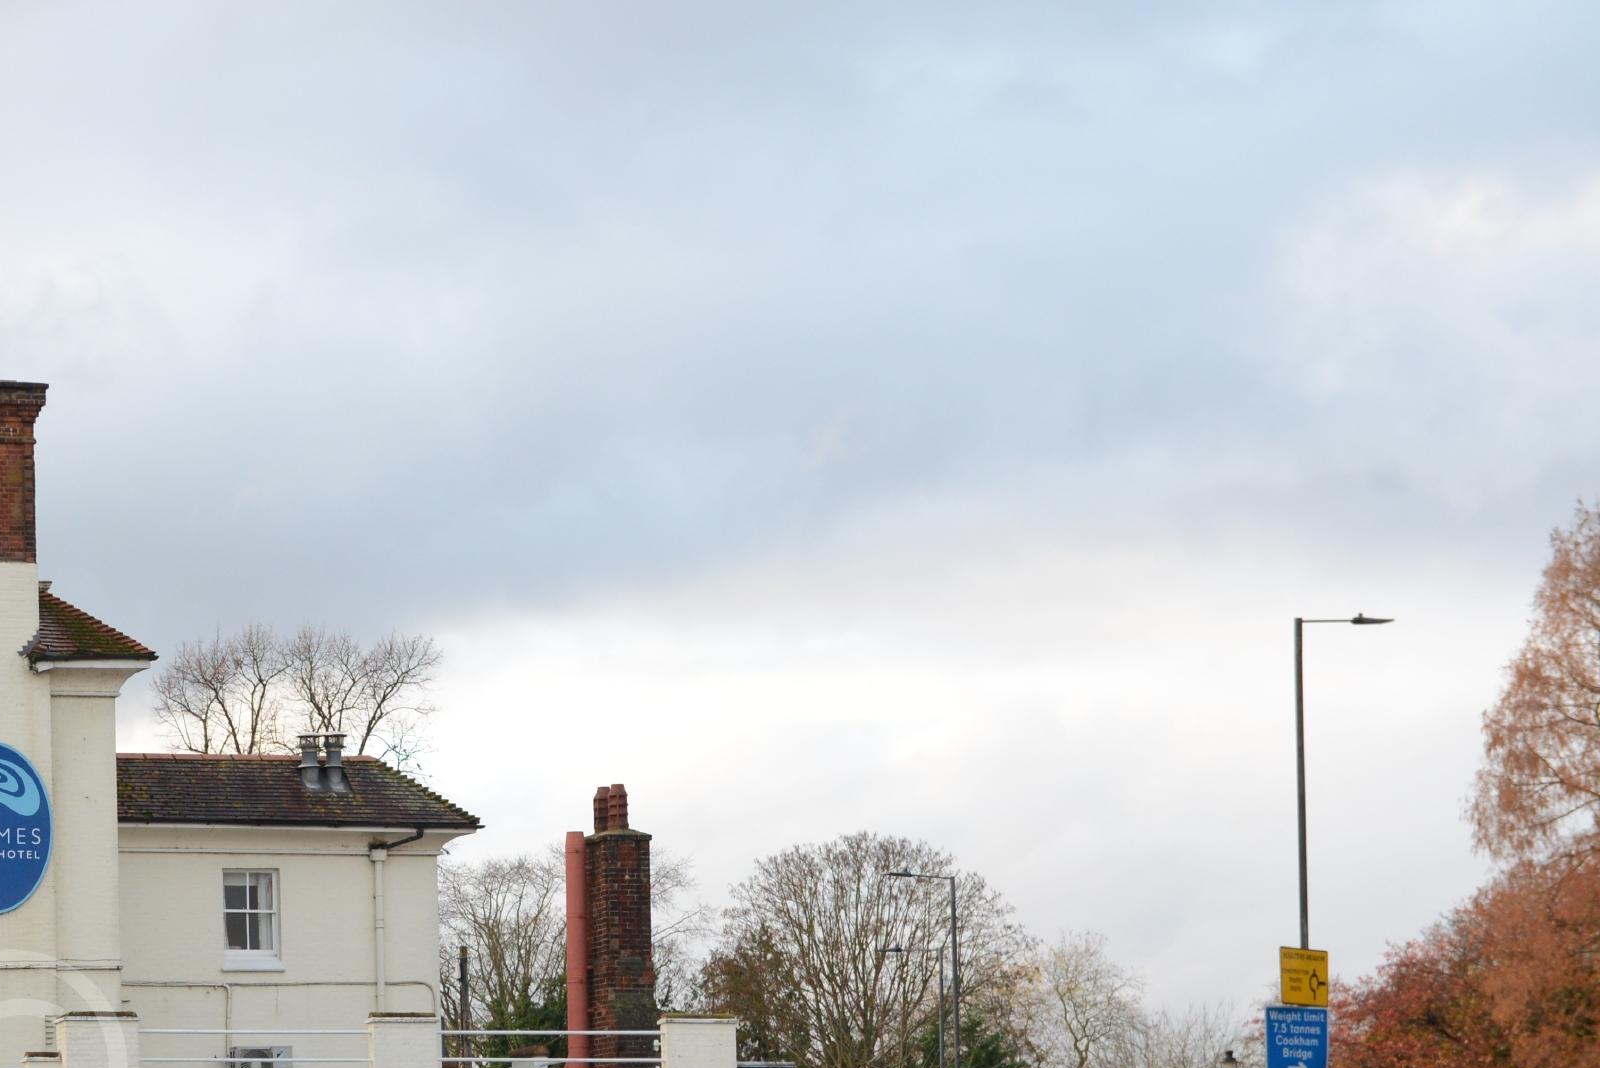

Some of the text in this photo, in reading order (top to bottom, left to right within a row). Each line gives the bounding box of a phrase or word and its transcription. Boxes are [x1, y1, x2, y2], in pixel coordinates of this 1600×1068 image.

[1269, 1010, 1325, 1023] Weight limit
[1273, 1023, 1321, 1035] 7.5 tonnes
[1275, 1035, 1319, 1046] Cookham
[1282, 1047, 1313, 1060] Bridge
